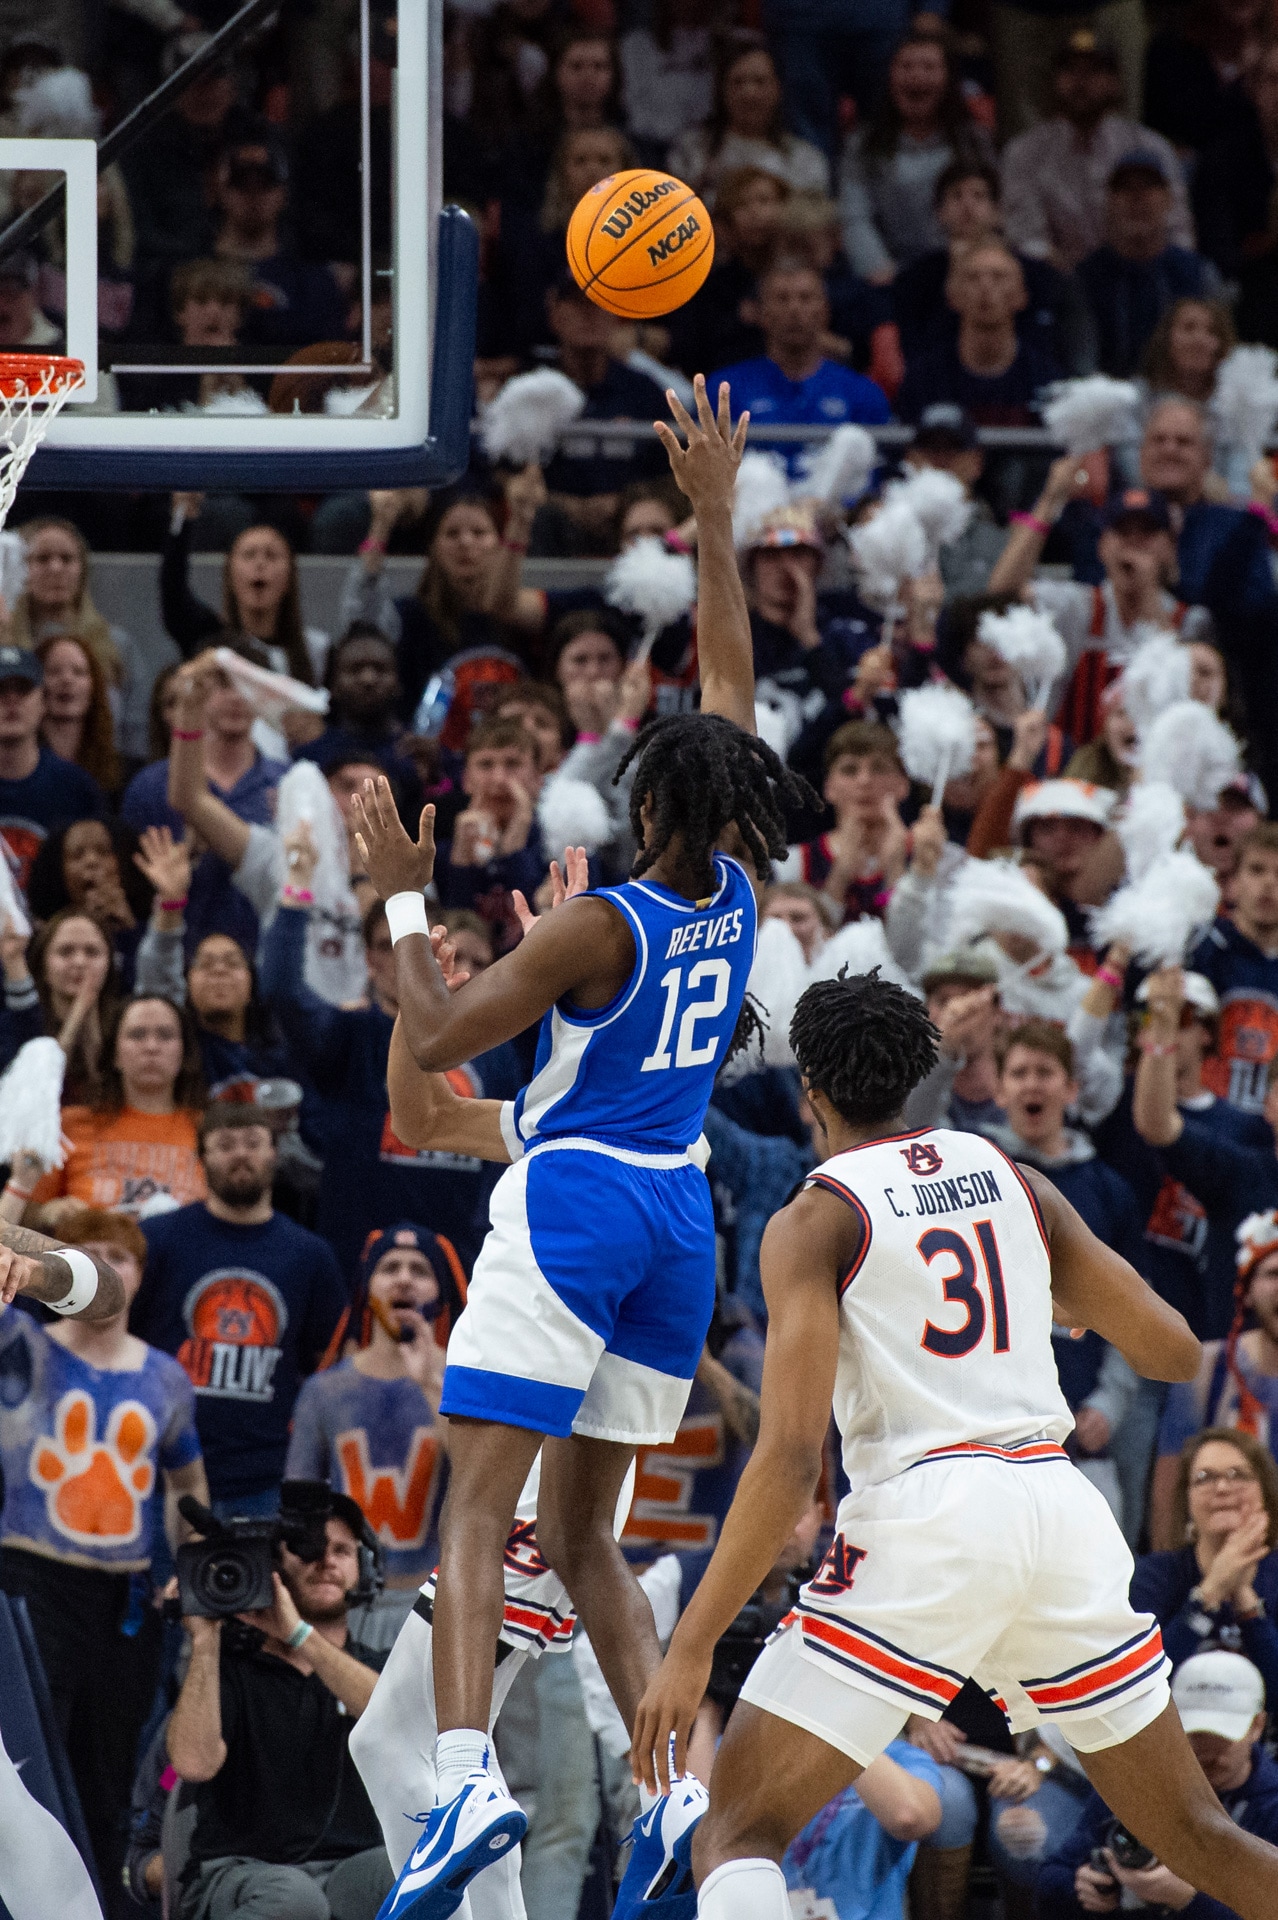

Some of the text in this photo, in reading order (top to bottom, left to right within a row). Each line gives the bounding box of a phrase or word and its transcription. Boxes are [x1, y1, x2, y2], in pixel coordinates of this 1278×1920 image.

[601, 180, 682, 239] Wilson
[647, 214, 700, 267] NCAA
[665, 908, 744, 960] REEVES
[640, 958, 732, 1072] 12
[884, 1169, 1003, 1218] C. JOHNSON
[915, 1219, 1011, 1359] 31
